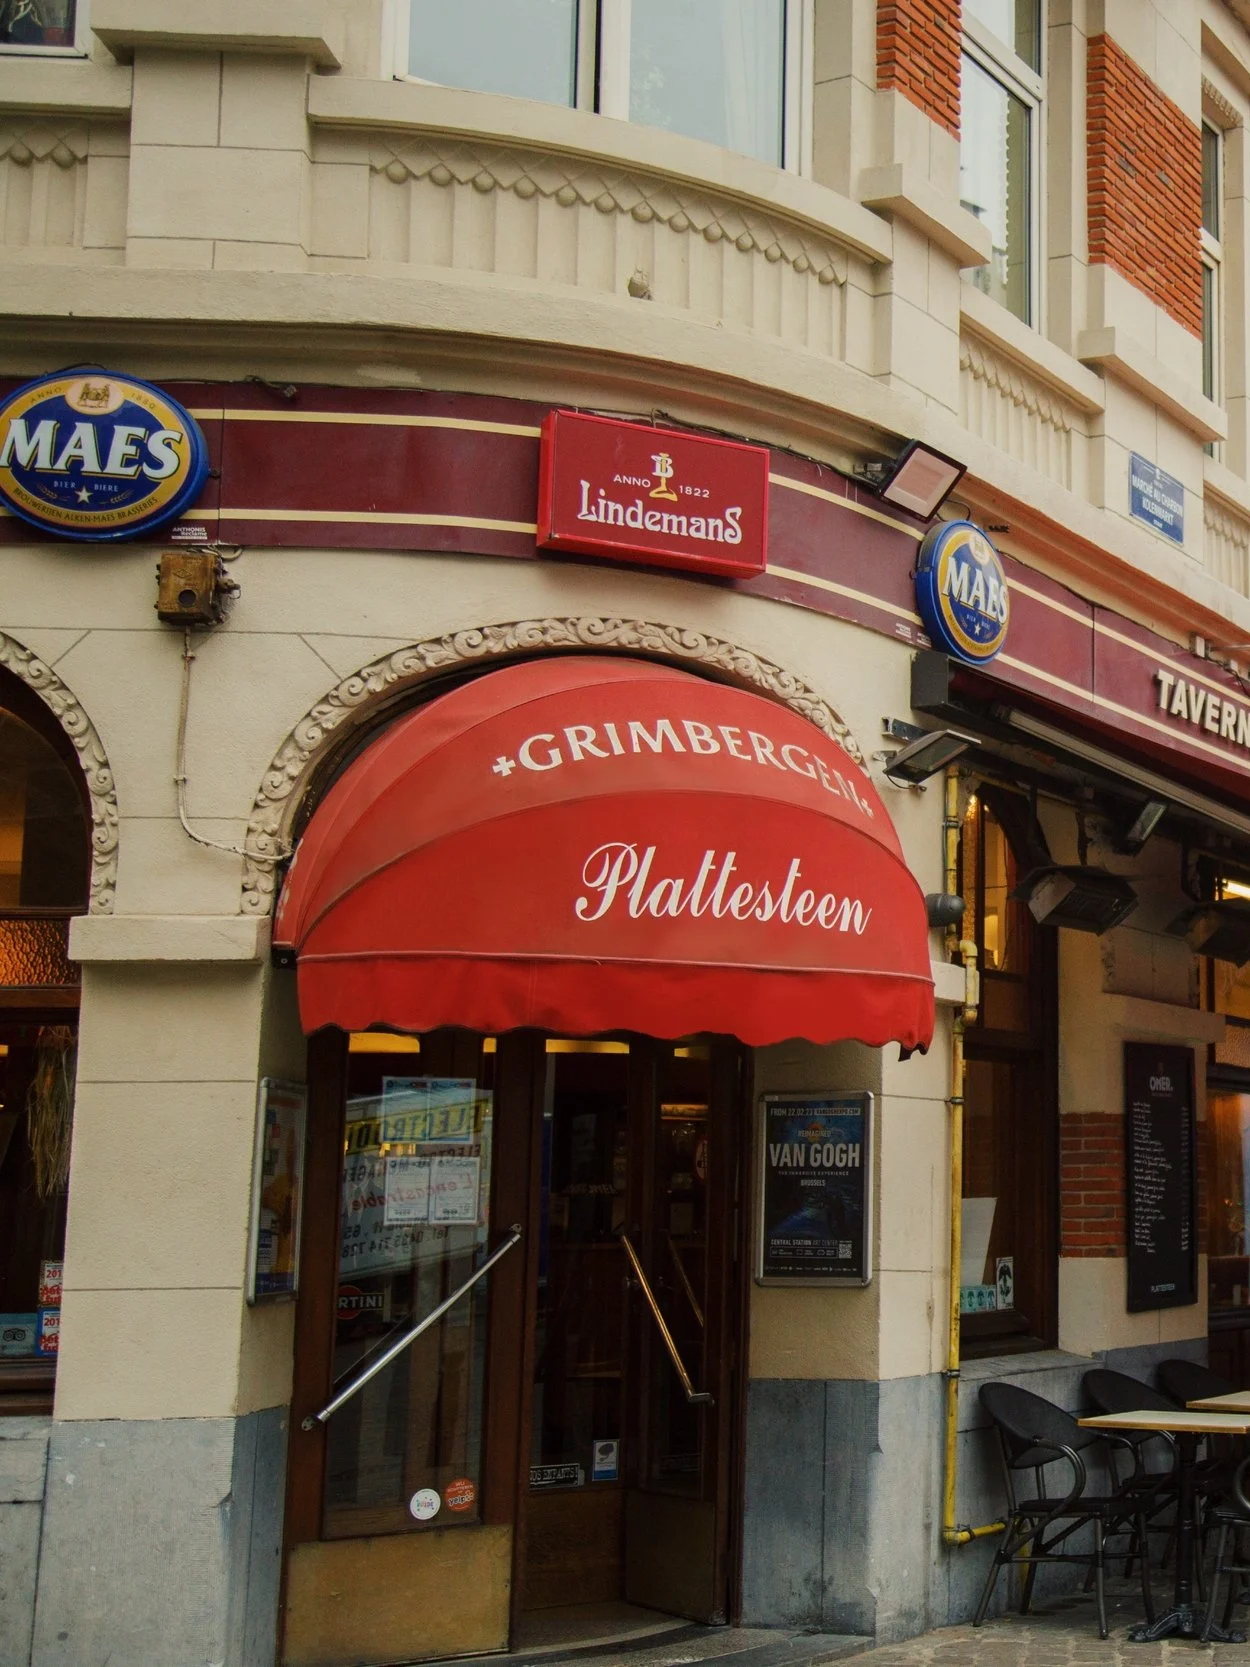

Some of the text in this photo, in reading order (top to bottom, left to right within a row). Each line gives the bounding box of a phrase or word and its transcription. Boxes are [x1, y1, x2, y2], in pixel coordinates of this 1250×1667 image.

[30, 386, 63, 404] ANNO
[0, 418, 184, 480] MAES
[53, 480, 77, 489] BIER
[613, 474, 711, 499] ANNO 1822
[117, 497, 159, 521] BRASSERIES
[941, 556, 1009, 626] MAES
[517, 718, 866, 810] GRIMBERGEN
[574, 841, 873, 936] Plattesteen
[769, 1143, 860, 1168] VAN GOGH
[338, 1295, 383, 1309] RTINI
